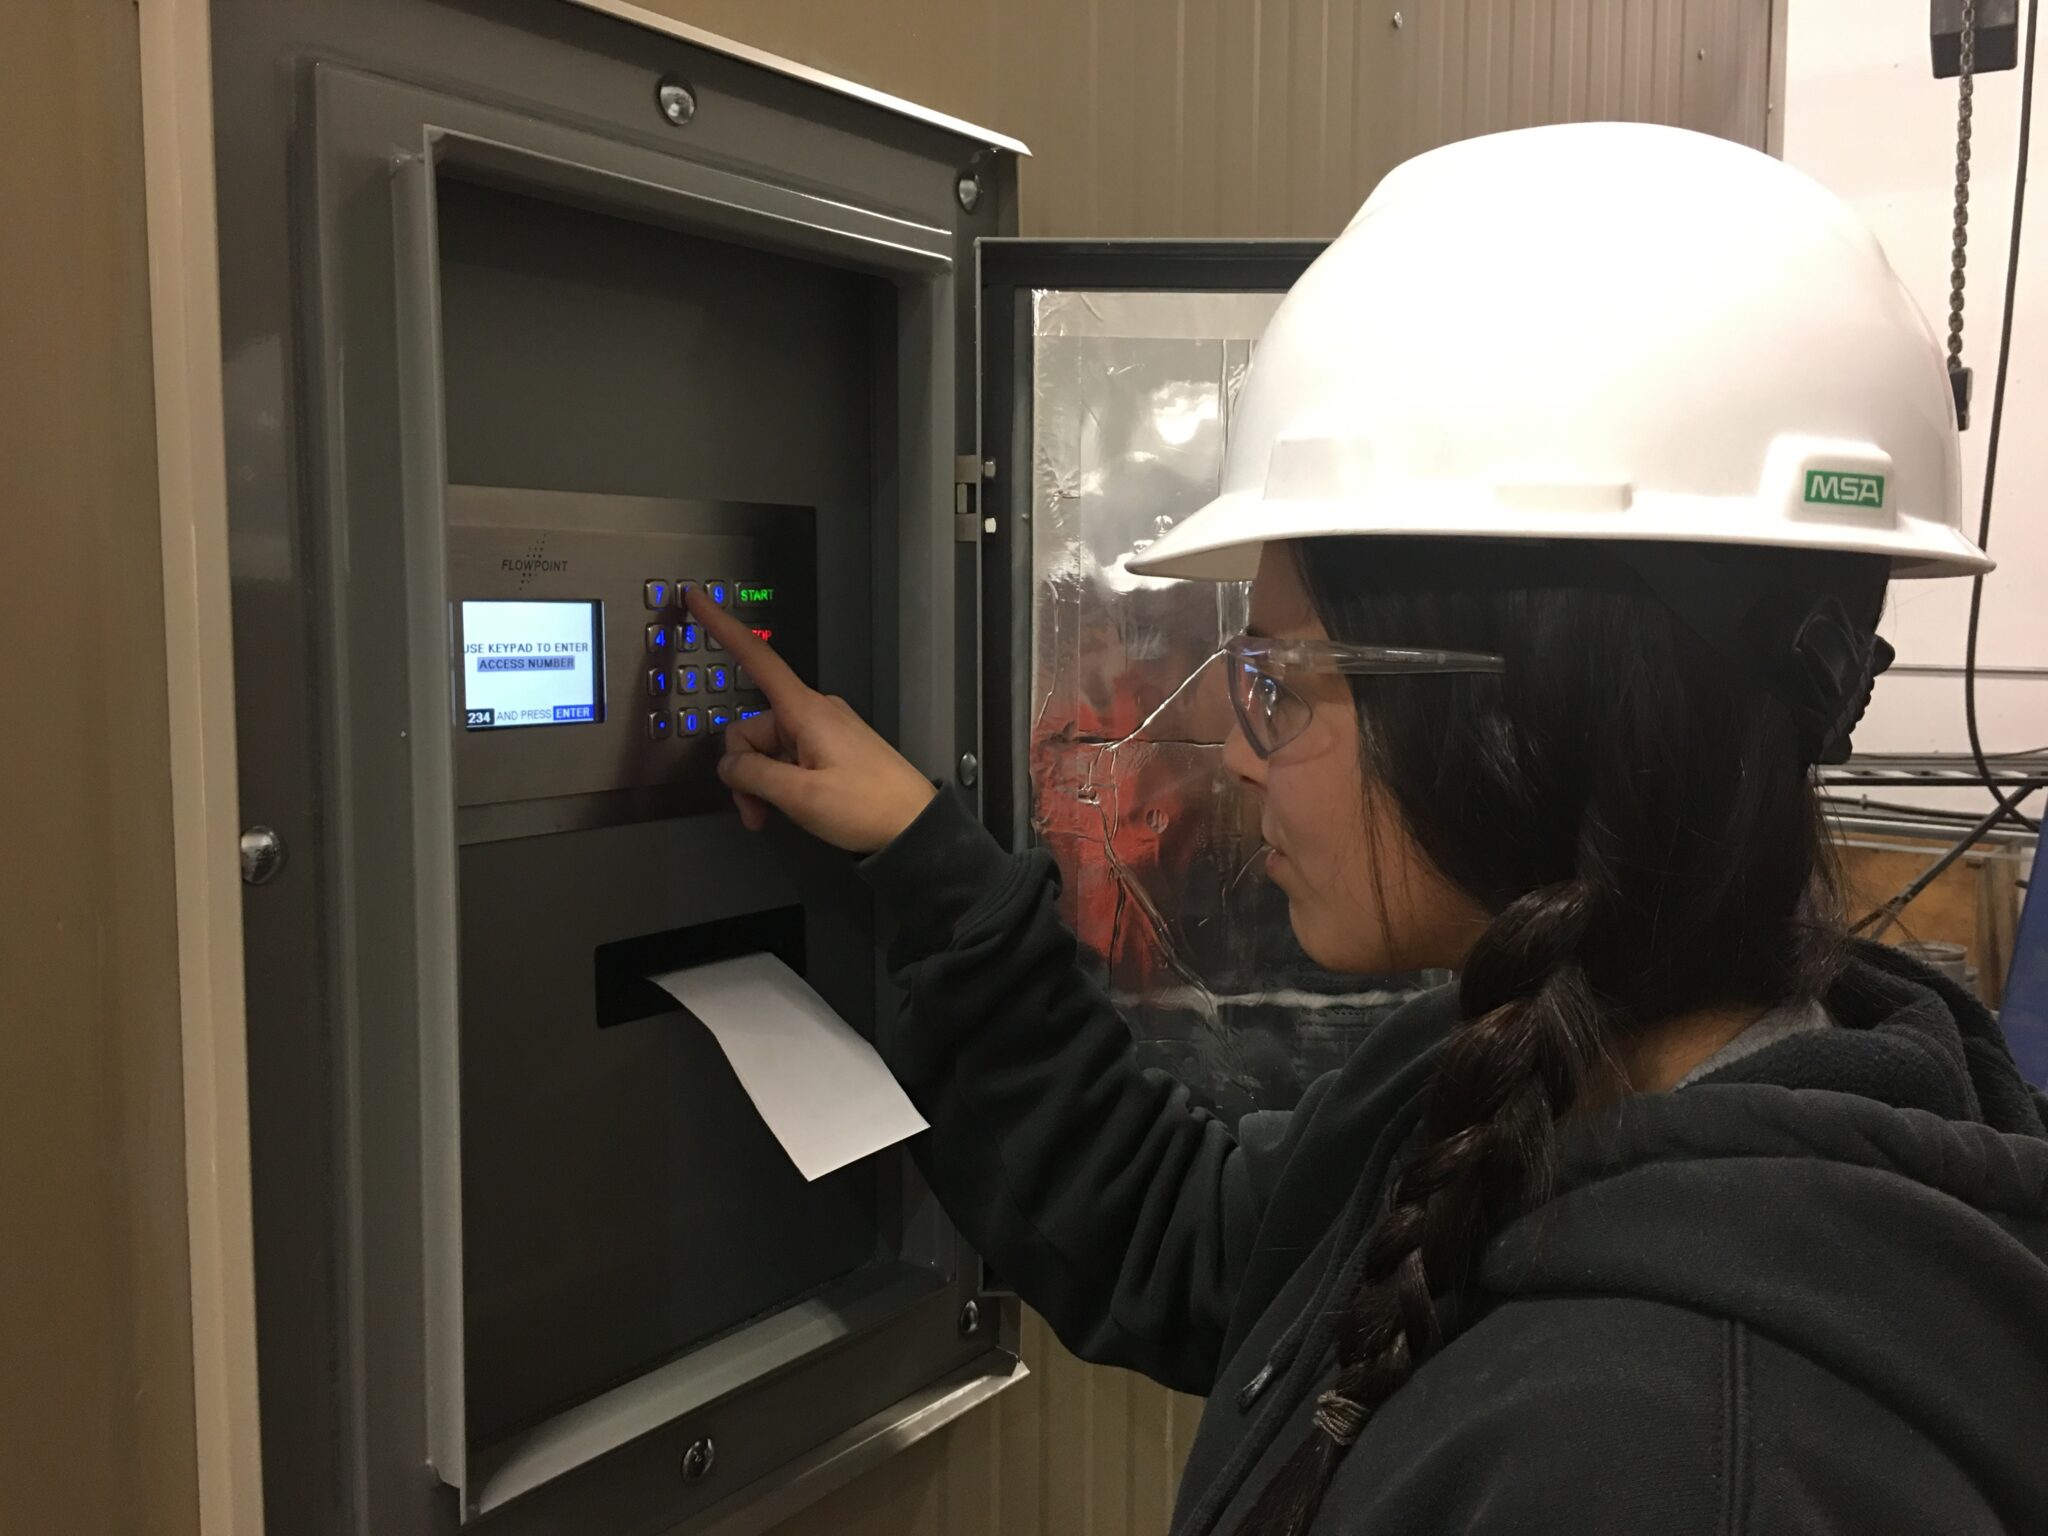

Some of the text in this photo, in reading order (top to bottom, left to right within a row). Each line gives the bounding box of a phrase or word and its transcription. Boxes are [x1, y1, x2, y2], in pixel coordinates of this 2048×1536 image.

[1810, 475, 1879, 503] MSA
[502, 559, 568, 571] FLOWPOINT
[655, 586, 664, 605] 7
[714, 586, 724, 604] 9
[740, 589, 774, 601] START
[656, 630, 665, 646] 4
[488, 643, 533, 653] KEYPAD
[537, 643, 551, 653] TO
[554, 642, 588, 653] ENTER
[479, 656, 575, 669] ACCESS NUMBER
[657, 673, 665, 690] 1
[687, 671, 696, 689] 2
[715, 669, 725, 688] 3
[497, 711, 518, 721] AND
[521, 709, 551, 720] PRESS
[556, 707, 590, 719] ENTER
[687, 713, 697, 731] 0
